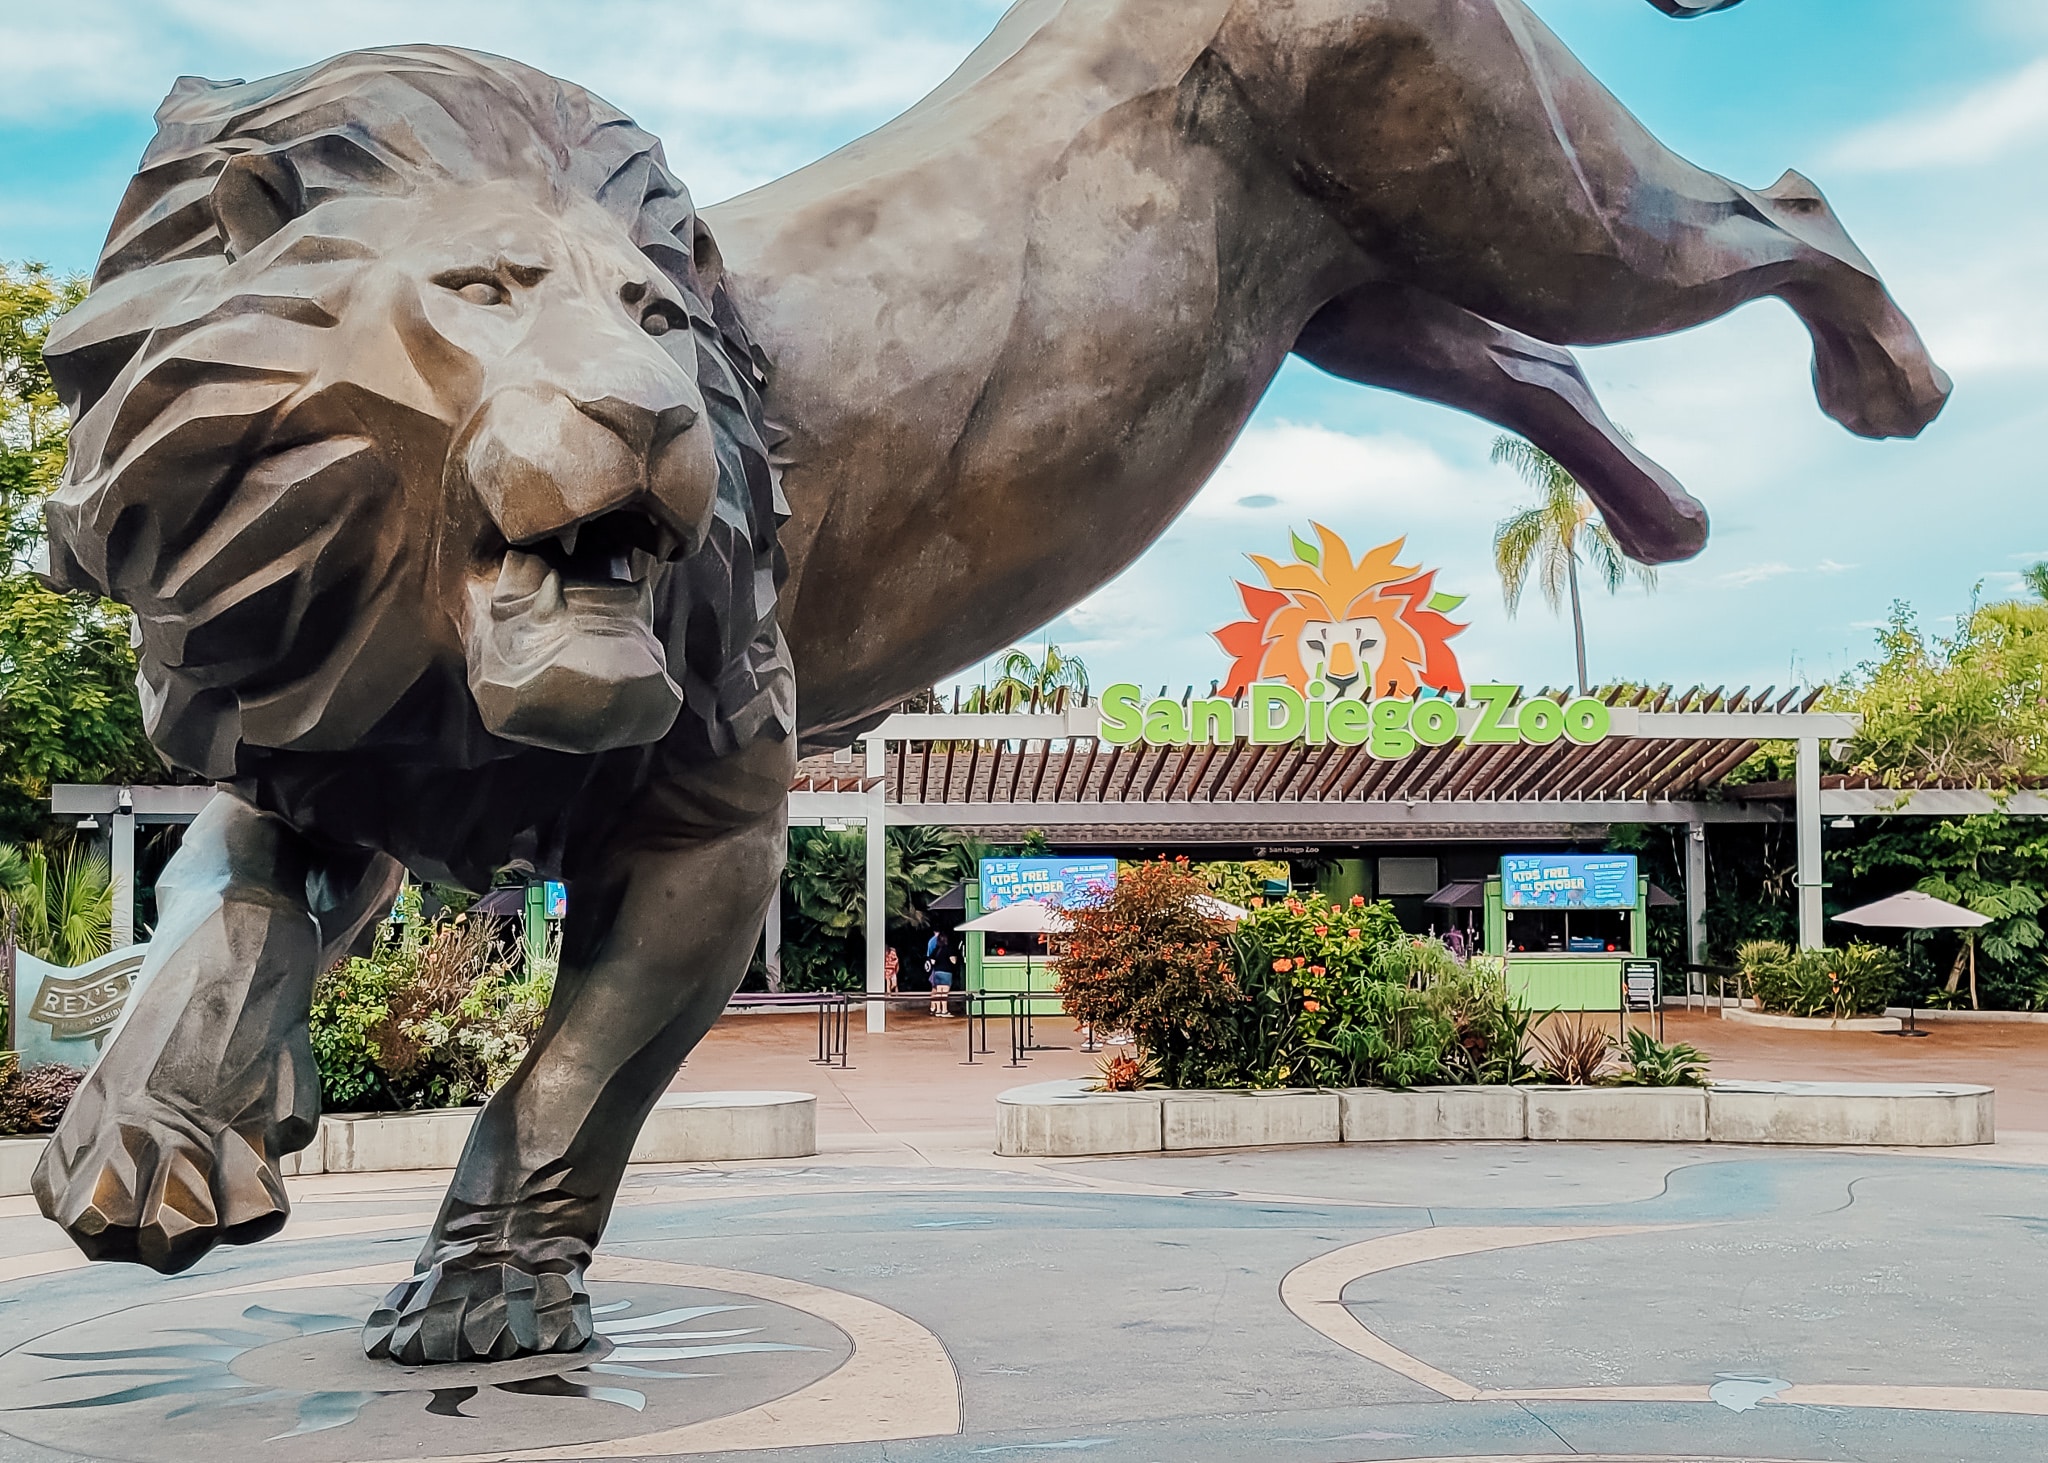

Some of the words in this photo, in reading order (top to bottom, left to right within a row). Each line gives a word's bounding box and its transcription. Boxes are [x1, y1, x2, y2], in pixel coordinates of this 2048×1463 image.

[1098, 683, 1236, 746] San
[1247, 680, 1459, 760] Diego
[1463, 684, 1612, 746] Zoo
[1284, 846, 1304, 854] Diego
[990, 872, 1019, 885] KIDS
[1022, 869, 1049, 882] FREE
[1512, 869, 1540, 882] KIDS
[1012, 881, 1063, 895] OCTOBER
[1534, 878, 1585, 892] OCTOBER
[1619, 911, 1625, 921] 7
[43, 982, 118, 1012] REX'S
[89, 1007, 121, 1025] POSSIB
